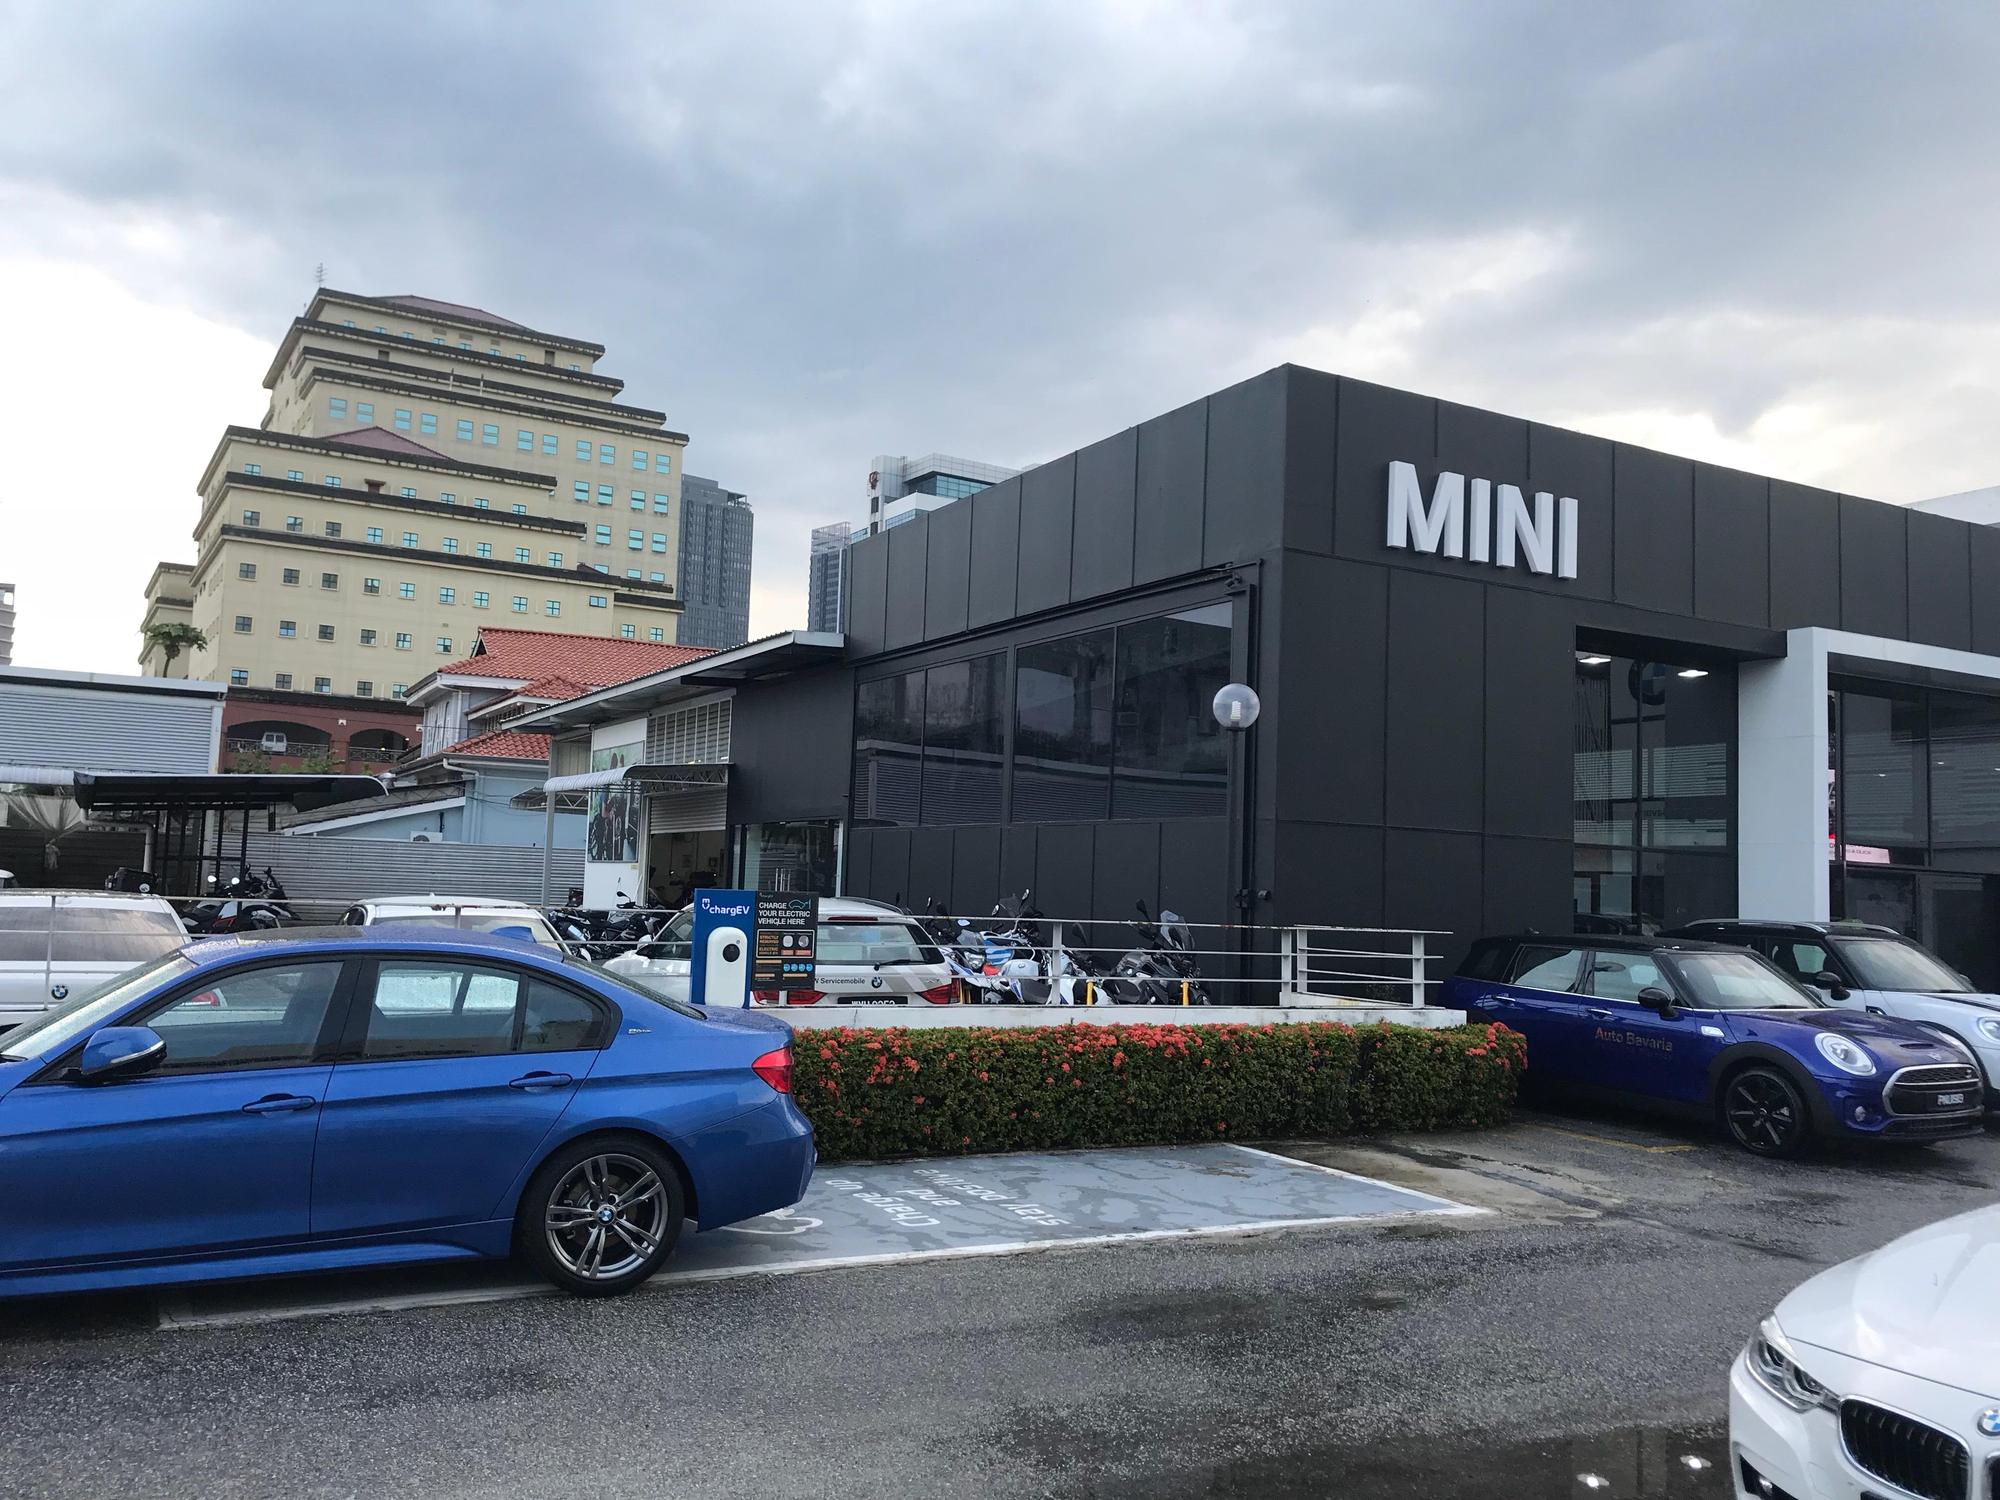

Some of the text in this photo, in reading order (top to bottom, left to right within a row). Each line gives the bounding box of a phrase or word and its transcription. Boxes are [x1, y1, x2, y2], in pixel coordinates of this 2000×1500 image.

[1387, 461, 1578, 579] MINI
[709, 905, 750, 916] chargEV
[1594, 1026, 1673, 1051] Auto Bavaria
[824, 1178, 941, 1227] Charge up
[896, 1188, 962, 1207] and
[912, 1168, 1071, 1226] stay positive
